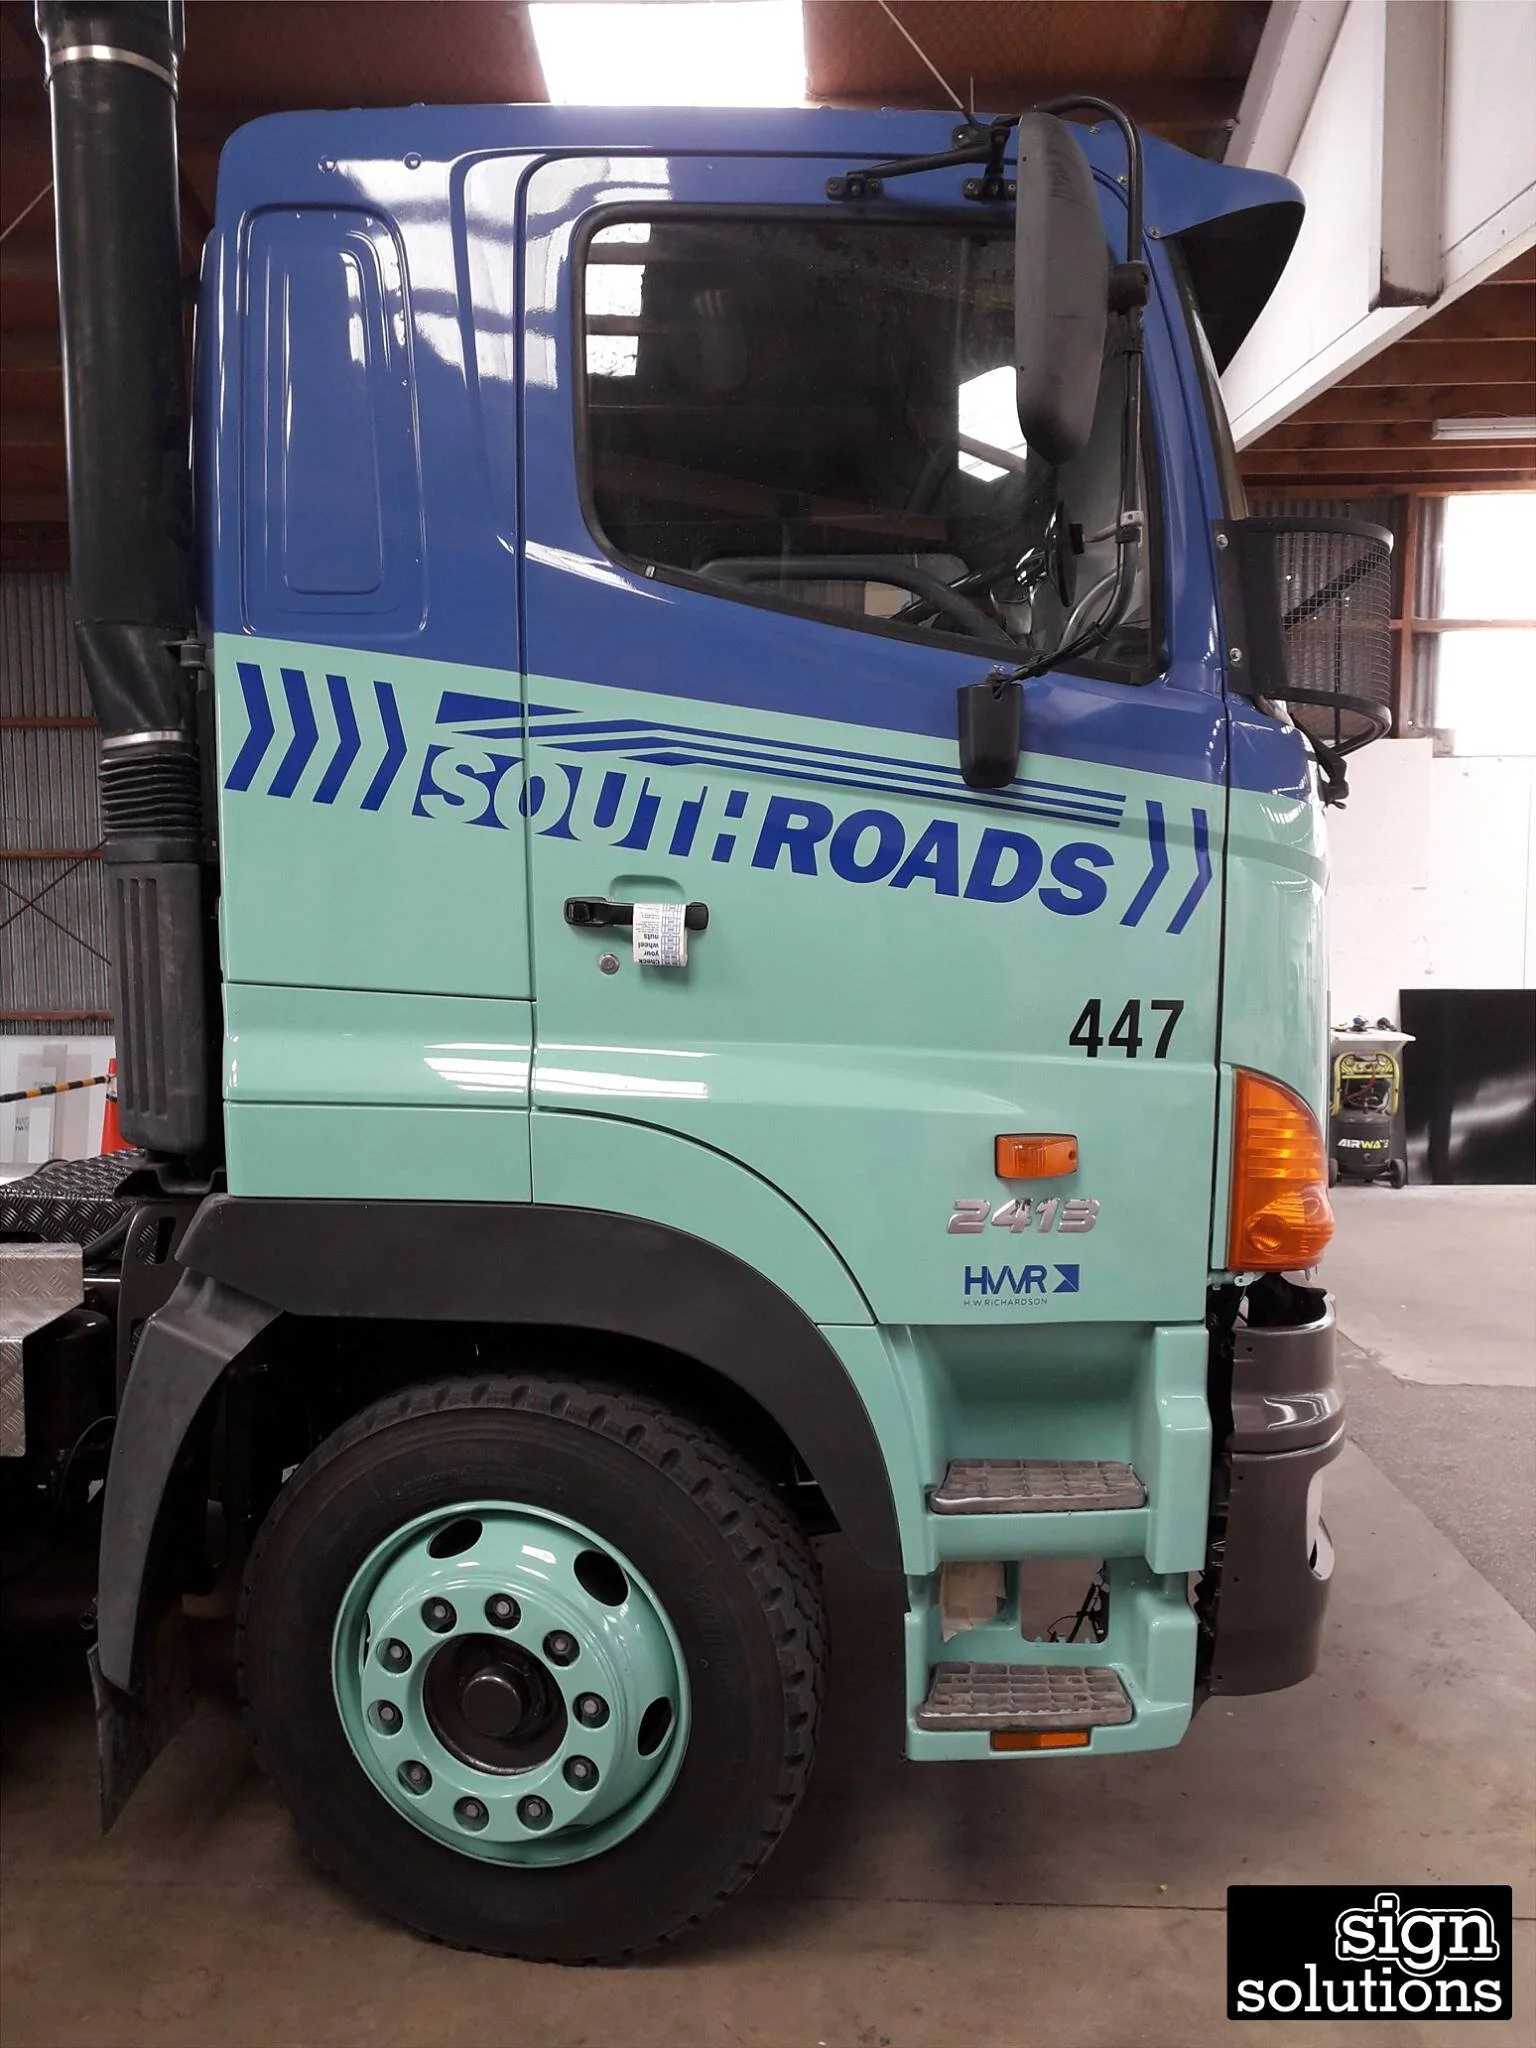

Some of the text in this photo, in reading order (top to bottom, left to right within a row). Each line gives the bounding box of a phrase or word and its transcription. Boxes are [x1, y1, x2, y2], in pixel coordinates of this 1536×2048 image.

[1068, 999, 1185, 1059] 447
[947, 1198, 1101, 1234] 2413
[964, 1264, 1048, 1295] HWR
